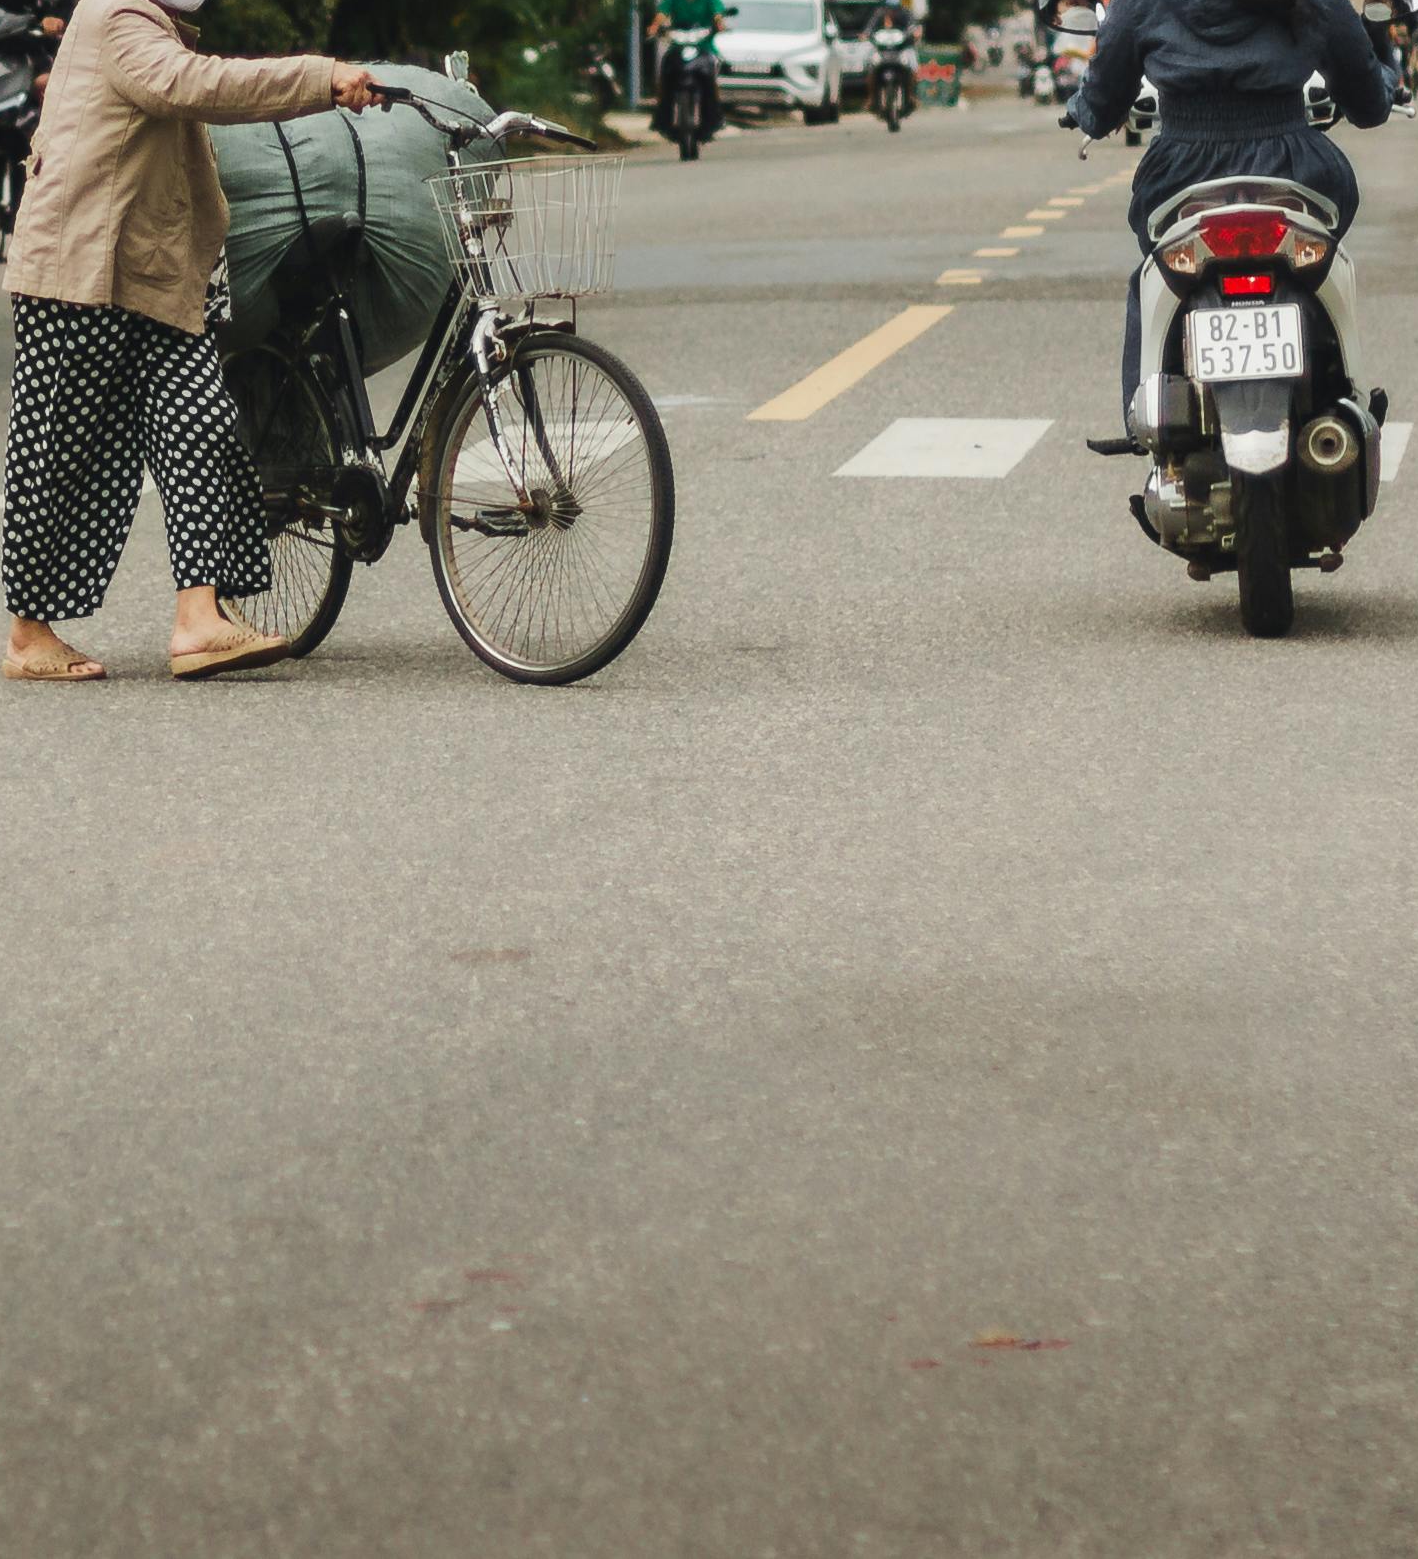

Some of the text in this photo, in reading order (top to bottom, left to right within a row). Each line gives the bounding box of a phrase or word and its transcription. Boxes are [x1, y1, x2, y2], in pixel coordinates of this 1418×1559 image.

[1231, 299, 1265, 307] HONDA
[1209, 310, 1282, 342] 82-B1
[1200, 342, 1296, 375] 537.50
